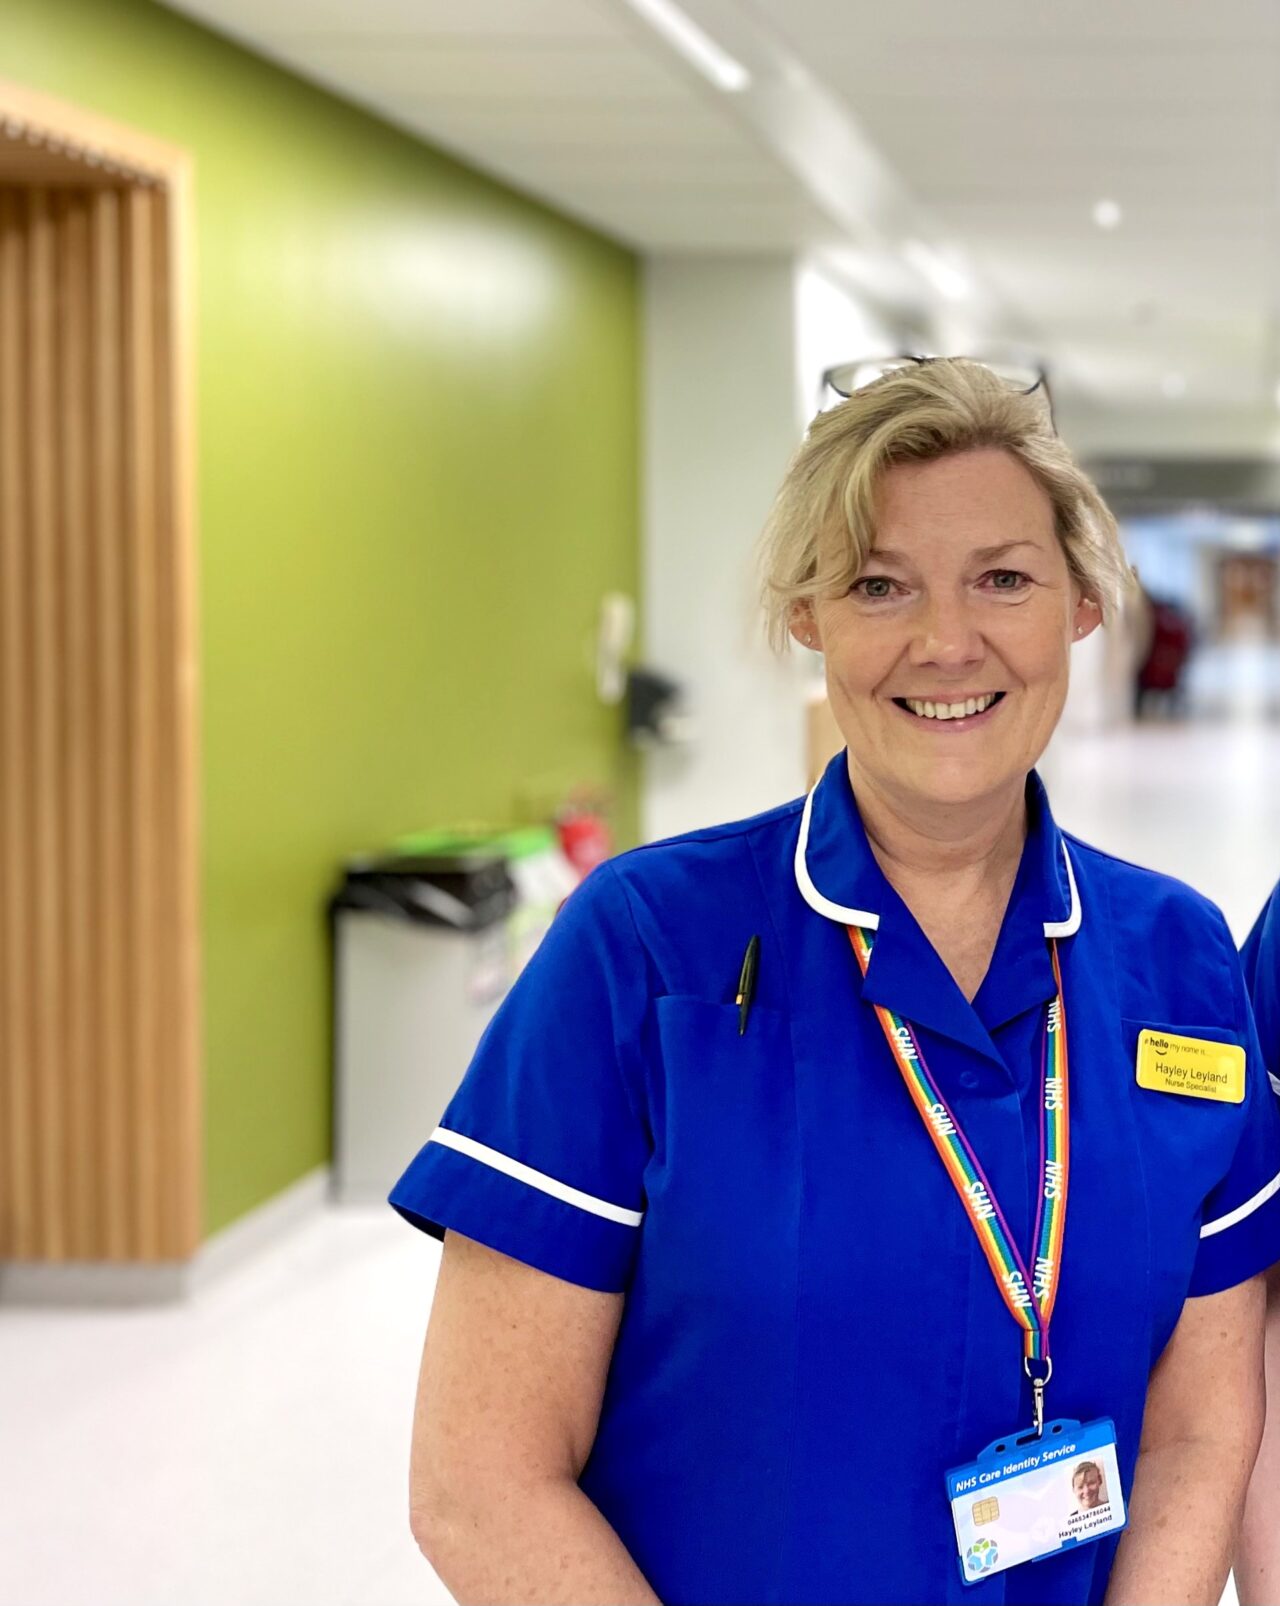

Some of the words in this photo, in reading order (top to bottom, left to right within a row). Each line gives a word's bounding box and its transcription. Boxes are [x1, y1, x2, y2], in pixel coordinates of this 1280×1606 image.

[1046, 1000, 1062, 1033] NHS
[890, 1026, 919, 1061] NHS
[1170, 1043, 1180, 1053] my
[1155, 1062, 1188, 1080] Hayley
[1190, 1068, 1228, 1084] Leyland
[1164, 1078, 1185, 1088] Nurse
[1186, 1081, 1217, 1094] Specialist
[1045, 1077, 1063, 1111] NHS
[925, 1103, 957, 1137] NHS
[1044, 1160, 1063, 1201] NHS
[964, 1181, 996, 1221] NHS
[1002, 1270, 1033, 1308] NHS
[1032, 1257, 1055, 1299] NHS
[956, 1477, 977, 1492] NHS
[979, 1470, 1001, 1484] Care
[1003, 1456, 1040, 1475] Identity
[1042, 1444, 1076, 1461] Service
[1058, 1525, 1083, 1538] Hayley
[1084, 1514, 1113, 1530] Leyland
